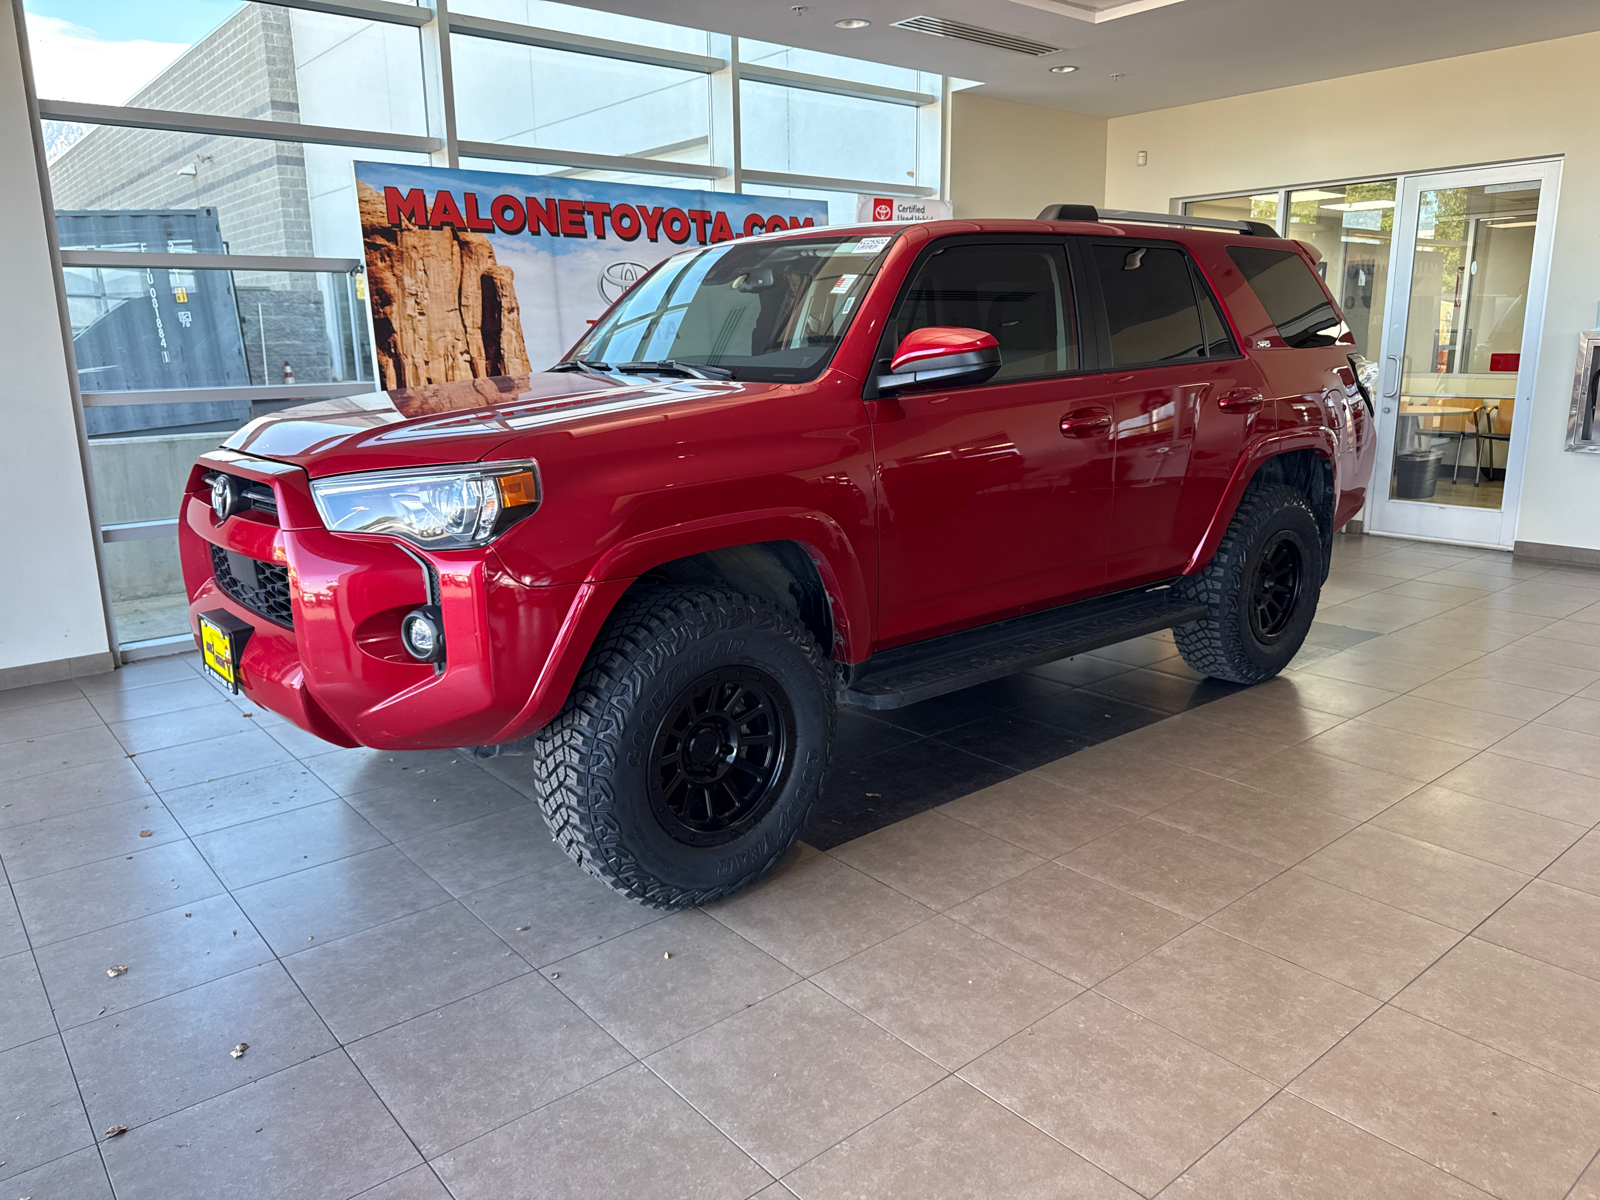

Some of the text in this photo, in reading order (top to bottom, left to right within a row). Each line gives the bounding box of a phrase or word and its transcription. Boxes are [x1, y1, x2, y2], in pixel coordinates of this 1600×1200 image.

[897, 204, 925, 214] Certified
[626, 638, 745, 768] GOODYEAR
[717, 748, 821, 876] GOODYEAR
